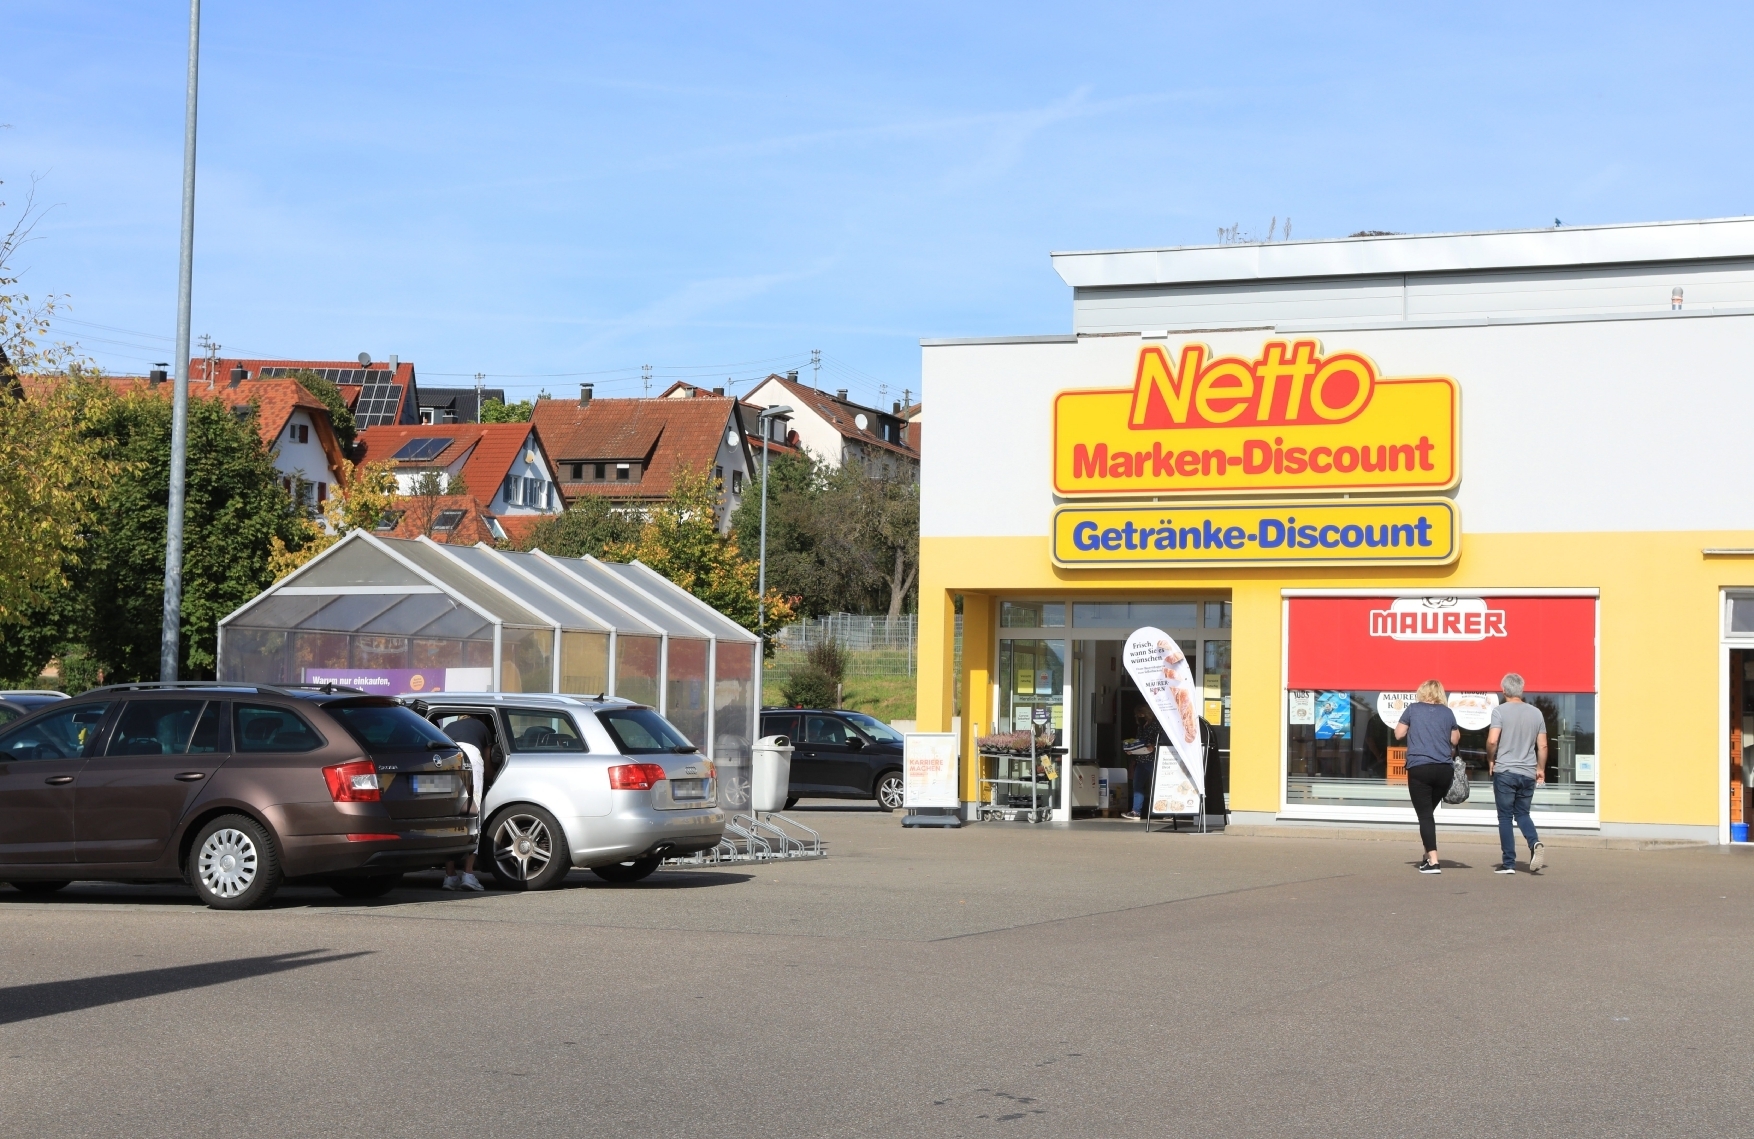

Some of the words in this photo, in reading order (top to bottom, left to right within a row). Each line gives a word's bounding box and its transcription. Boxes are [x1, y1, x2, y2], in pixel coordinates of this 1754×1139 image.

[1130, 343, 1372, 428] Netto
[1073, 436, 1434, 479] Marken-Discount
[1073, 516, 1432, 551] Getränke-Discount
[1372, 612, 1505, 634] MAURER
[1132, 641, 1153, 650] Frisch,
[312, 676, 338, 685] Warum
[339, 677, 352, 685] nur
[353, 677, 391, 686] einkaufen,
